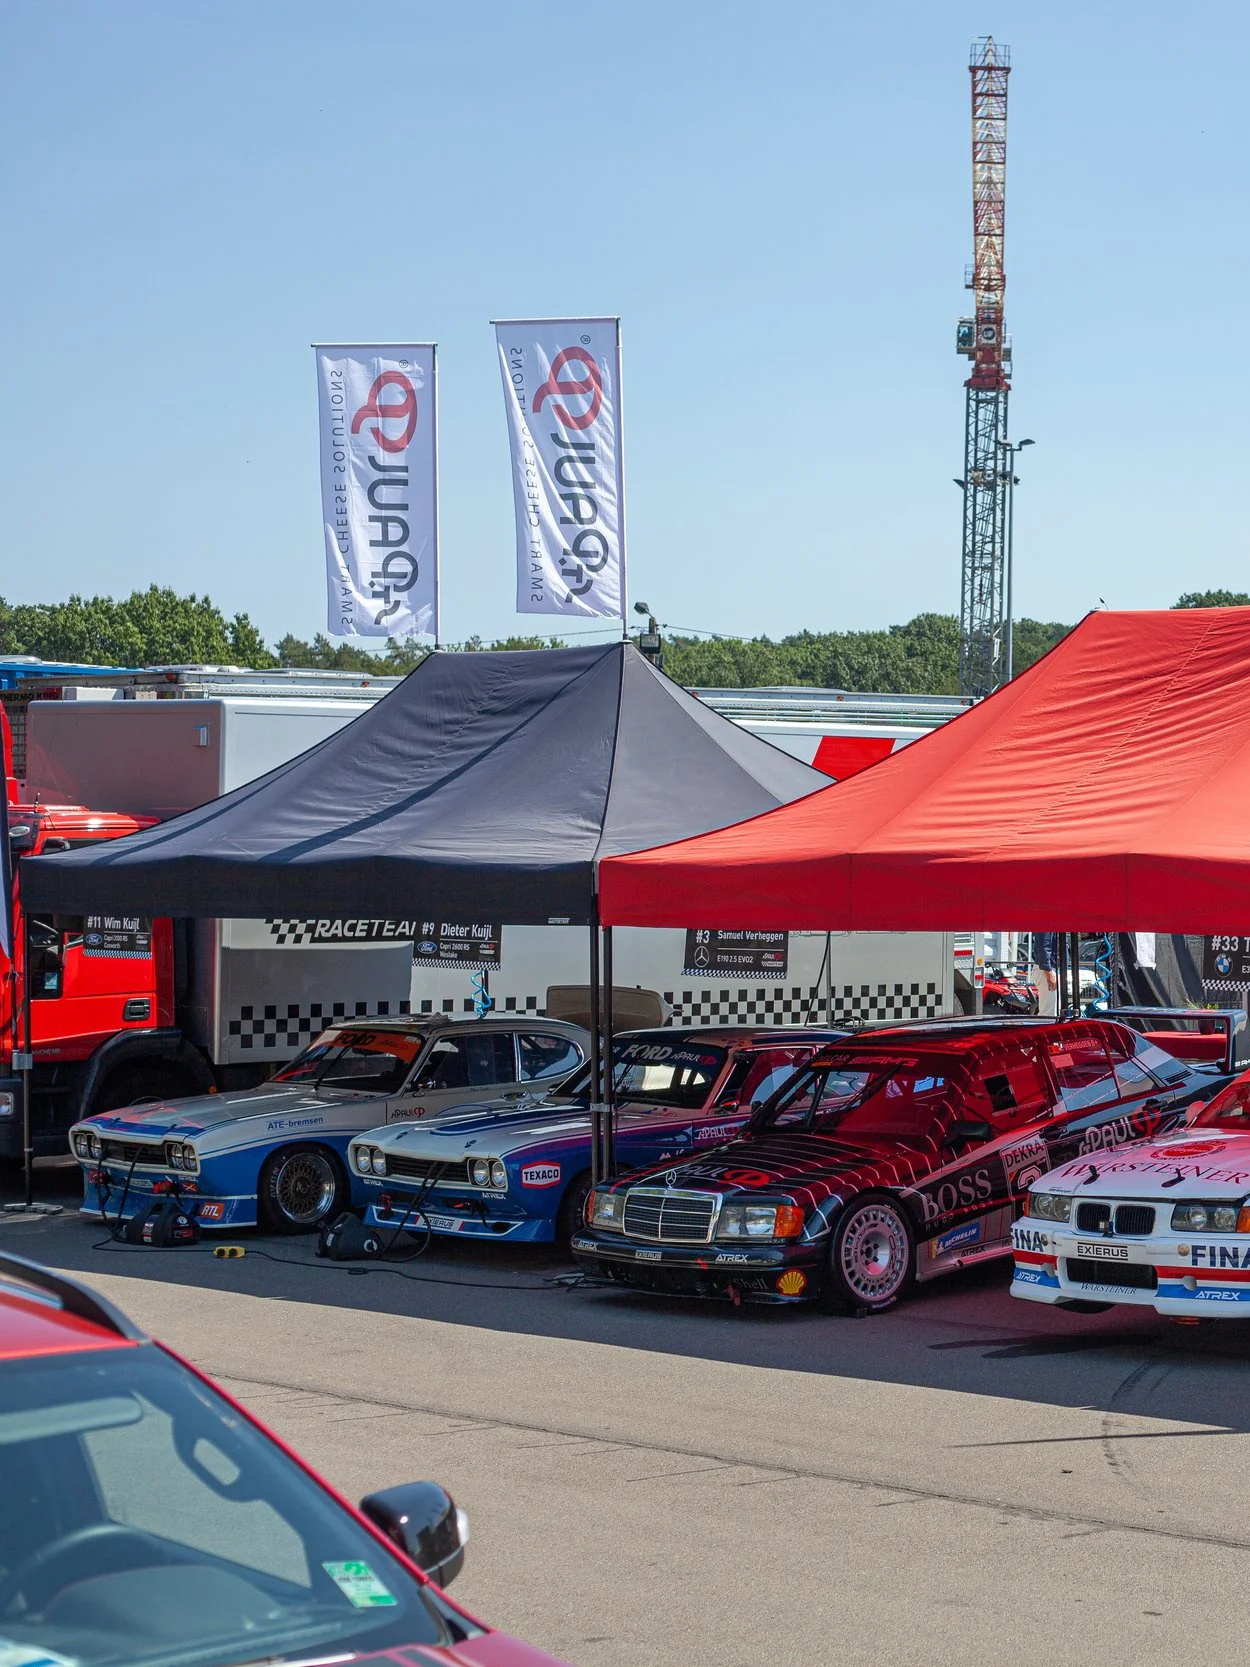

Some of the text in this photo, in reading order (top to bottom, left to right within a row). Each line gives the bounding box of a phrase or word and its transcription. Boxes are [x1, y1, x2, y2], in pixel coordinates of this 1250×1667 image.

[87, 916, 140, 932] #11 Wim Kuijl
[421, 922, 493, 940] #9 Dieter Kuijl
[695, 929, 784, 943] #3 Samuel Verheggen
[1211, 935, 1239, 952] #33
[729, 955, 737, 963] 2.5
[620, 1044, 674, 1061] FORD
[267, 1116, 324, 1131] ATE-bremsen
[1005, 1143, 1044, 1168] DEKRA
[523, 1168, 560, 1182] TEXACO
[1061, 1163, 1249, 1184] WARSTEINER
[922, 1169, 992, 1223] BOSS
[201, 1204, 220, 1217] RTL
[577, 1240, 599, 1250] ATREX
[960, 1245, 986, 1258] ATREX
[1077, 1243, 1128, 1258] EXTERUS
[715, 1253, 749, 1263] ATREX
[733, 1277, 769, 1290] Shell
[1016, 1270, 1041, 1283] ATREX
[1080, 1282, 1138, 1295] WARSTEINER
[1195, 1290, 1241, 1301] ATREX
